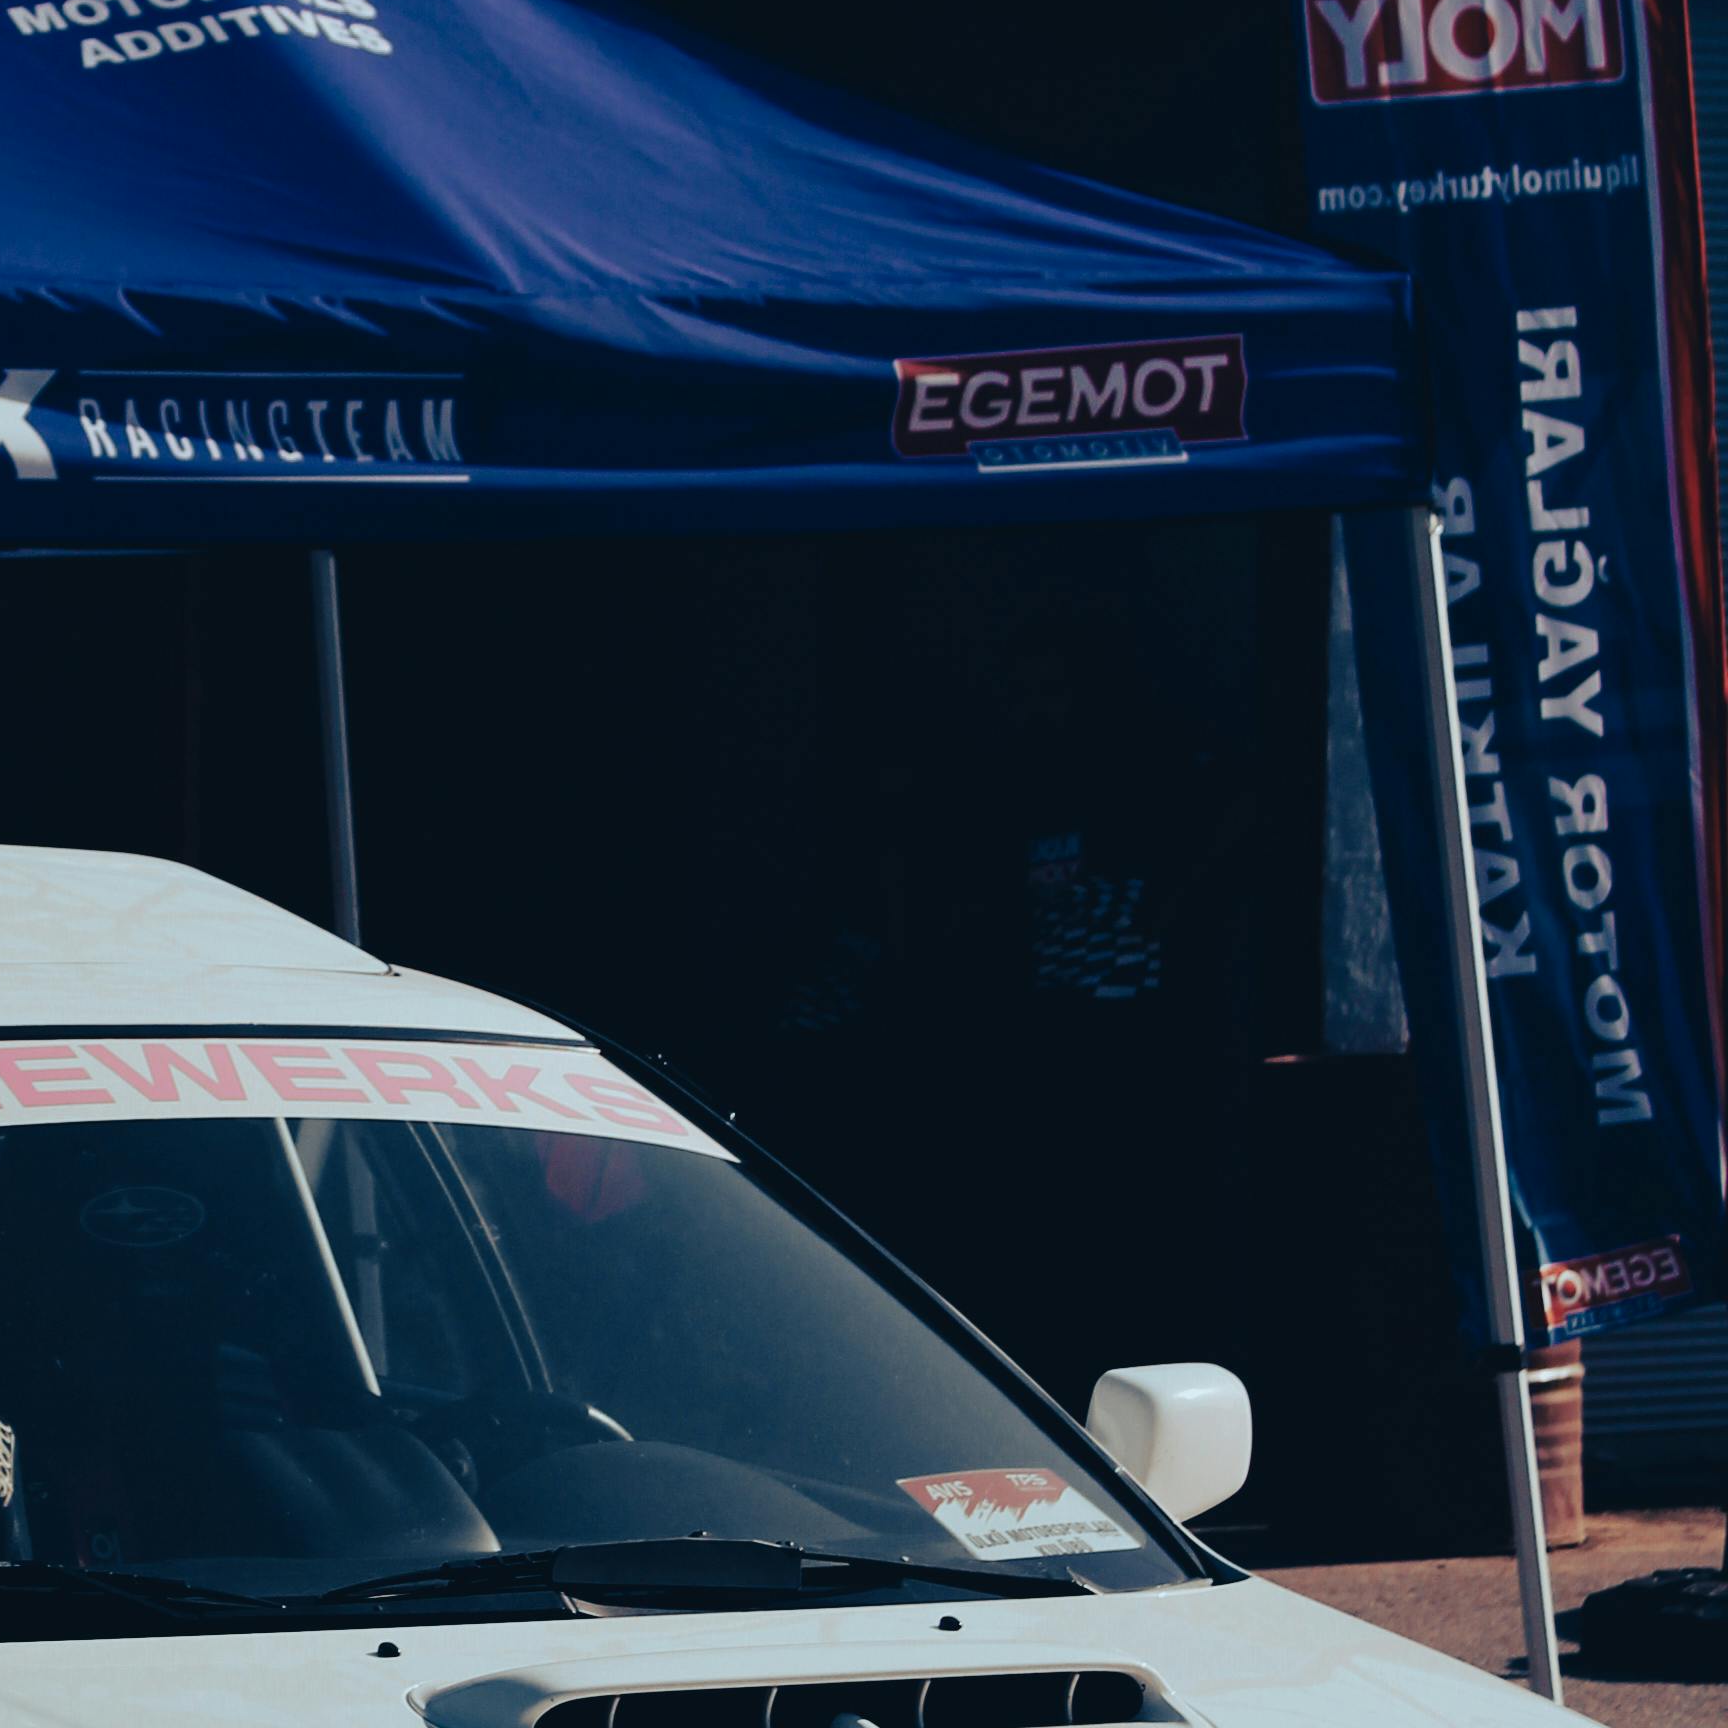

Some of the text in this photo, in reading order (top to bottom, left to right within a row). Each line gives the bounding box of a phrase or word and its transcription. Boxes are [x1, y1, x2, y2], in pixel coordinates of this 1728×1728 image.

[80, 3, 393, 70] ADDITIVES
[908, 354, 1229, 433] EGEMOT
[78, 397, 463, 463] RACINGTEAM
[924, 1480, 974, 1501] AVIS
